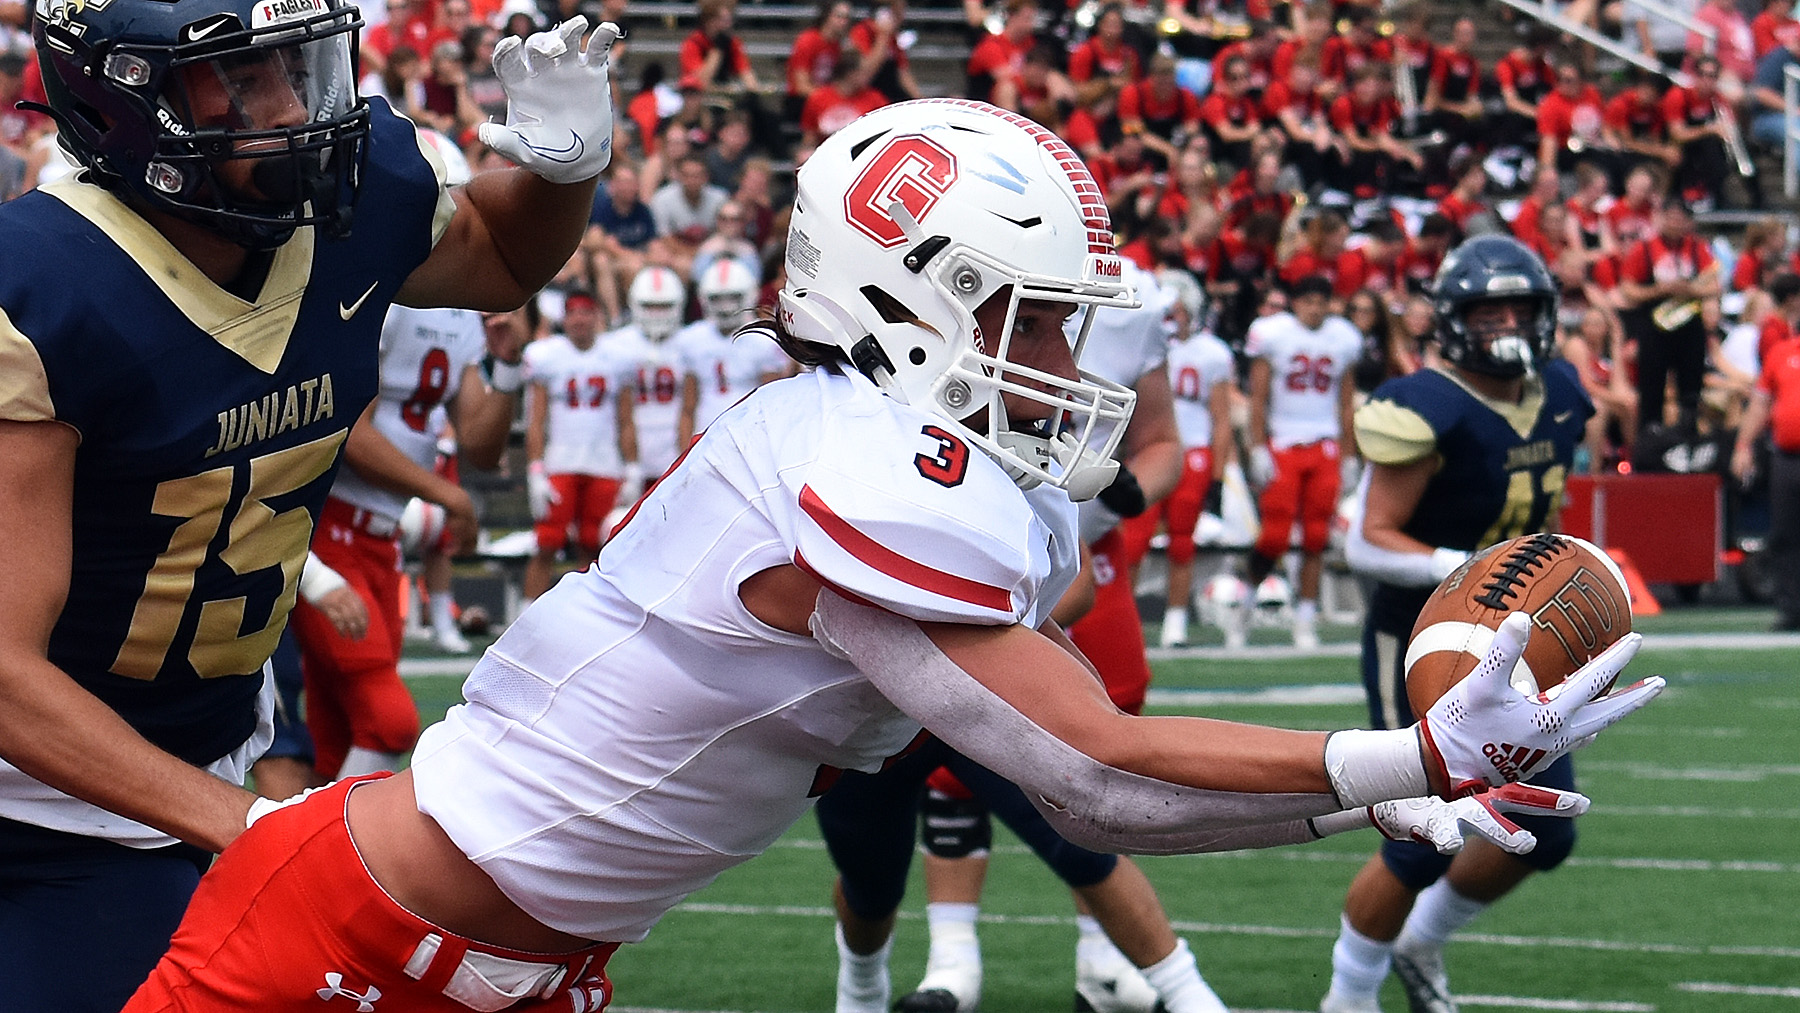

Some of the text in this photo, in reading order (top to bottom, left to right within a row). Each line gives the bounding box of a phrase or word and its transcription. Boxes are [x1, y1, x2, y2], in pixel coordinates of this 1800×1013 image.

[316, 66, 338, 122] Ridde
[843, 133, 958, 249] G
[402, 347, 450, 434] 8
[567, 375, 606, 408] 17
[716, 361, 728, 394] 1
[1286, 354, 1332, 393] 26
[204, 373, 335, 459] JUNIATA
[913, 425, 971, 488] 3
[1481, 742, 1520, 783] adida
